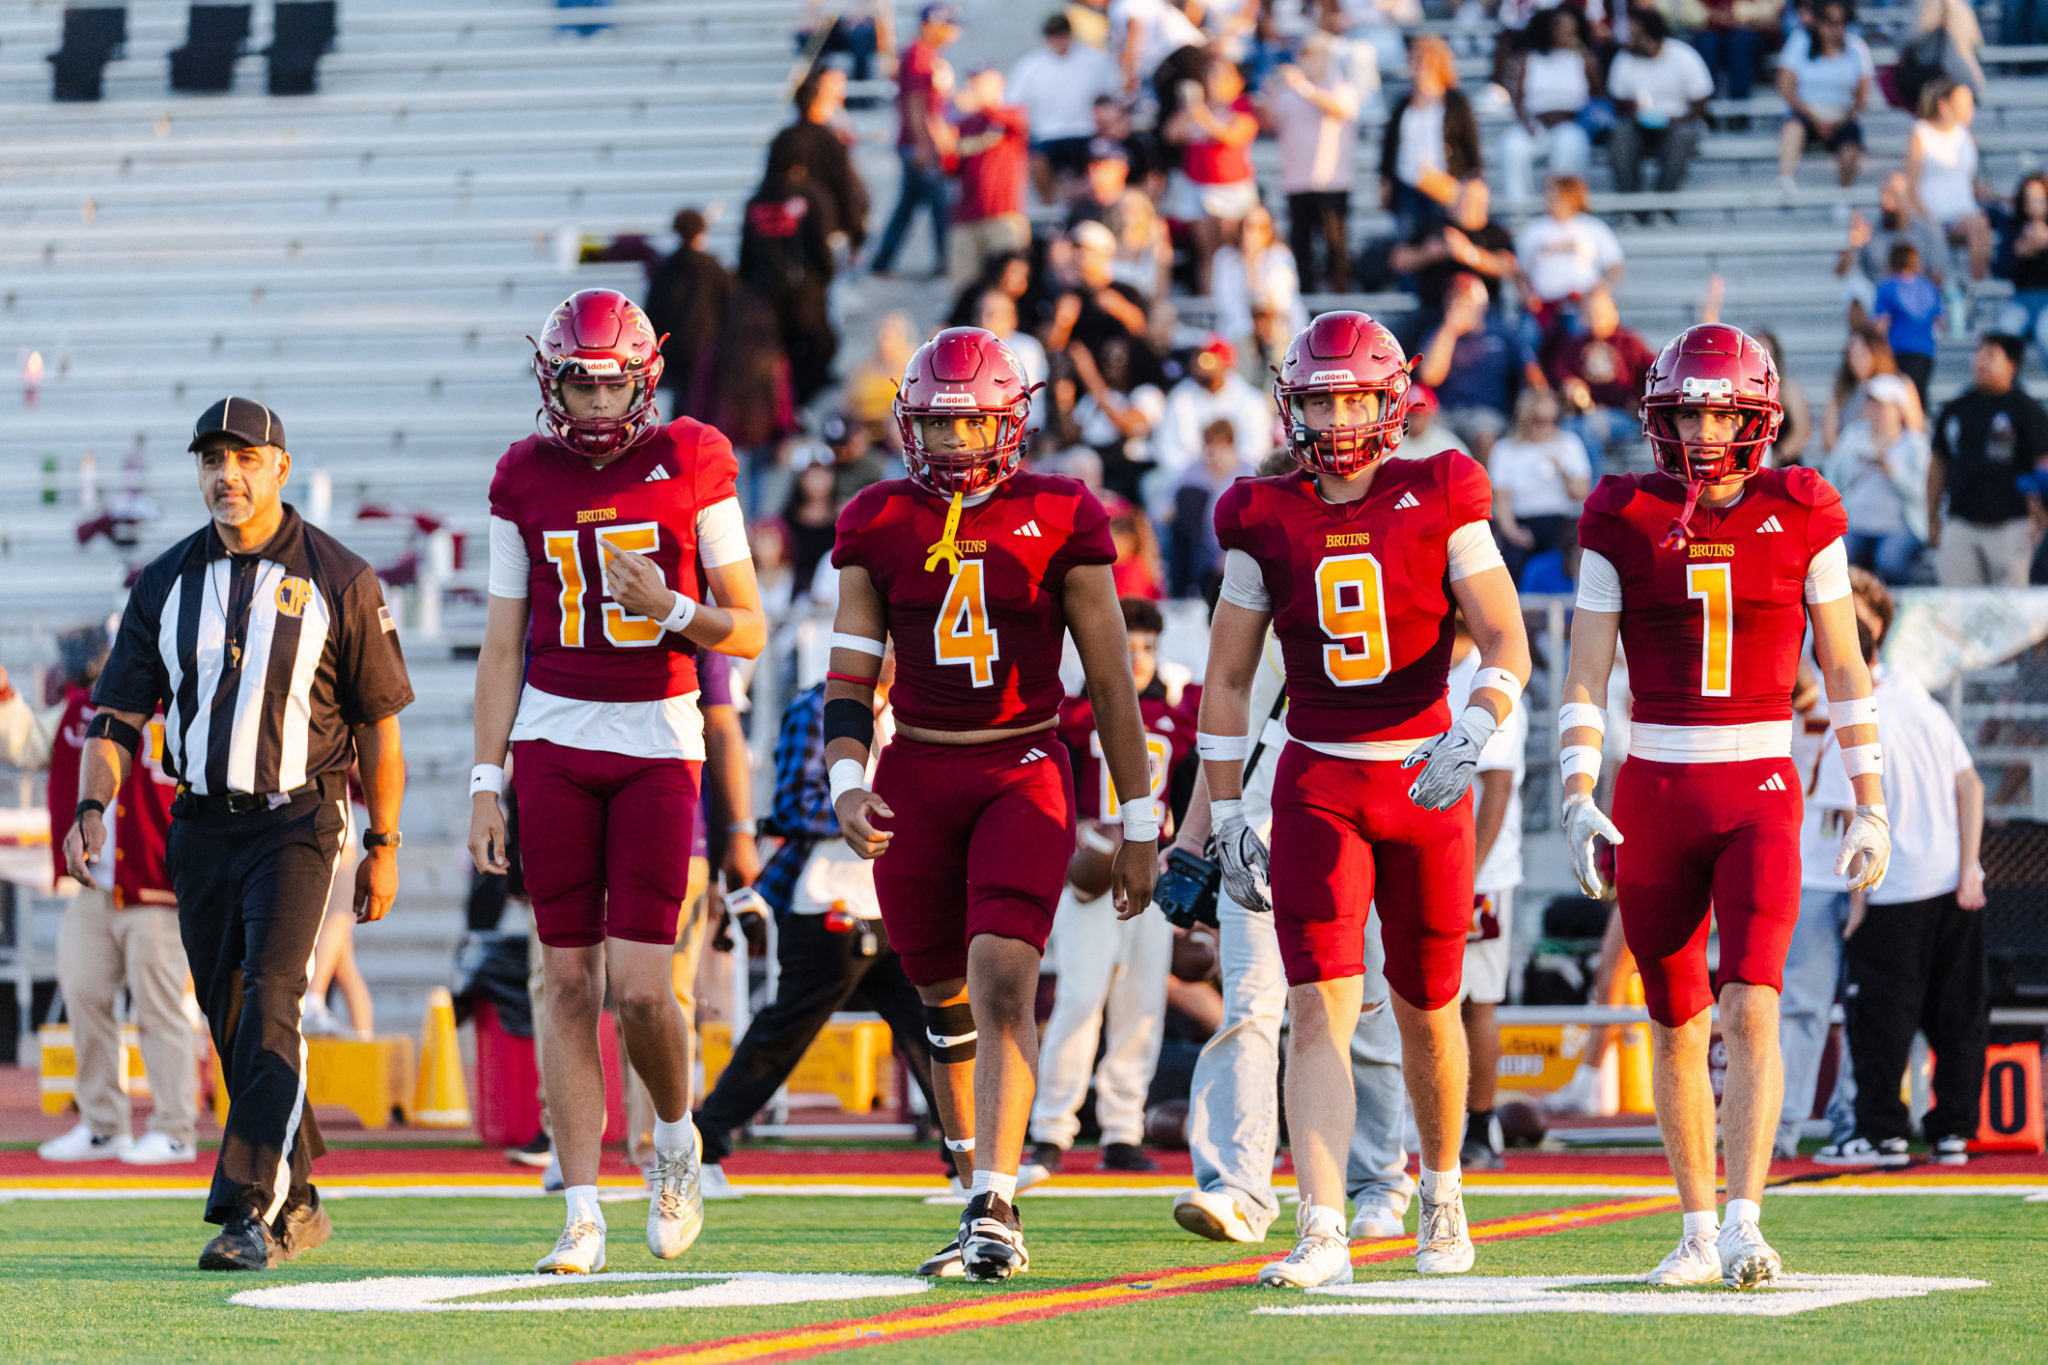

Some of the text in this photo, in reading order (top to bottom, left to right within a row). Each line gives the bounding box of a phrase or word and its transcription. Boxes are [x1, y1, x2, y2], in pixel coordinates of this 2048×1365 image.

[585, 361, 614, 371] iddell
[936, 396, 970, 404] Riddell
[576, 507, 617, 524] BRUINS
[954, 540, 987, 553] UINS
[1325, 532, 1370, 548] BRUINS
[1688, 543, 1735, 558] BRUINS
[275, 578, 313, 616] CIF
[542, 521, 667, 648] 15
[933, 558, 1000, 688] 4
[1314, 552, 1392, 687] 9
[1686, 562, 1734, 697] 1
[1989, 1060, 2027, 1135] 0
